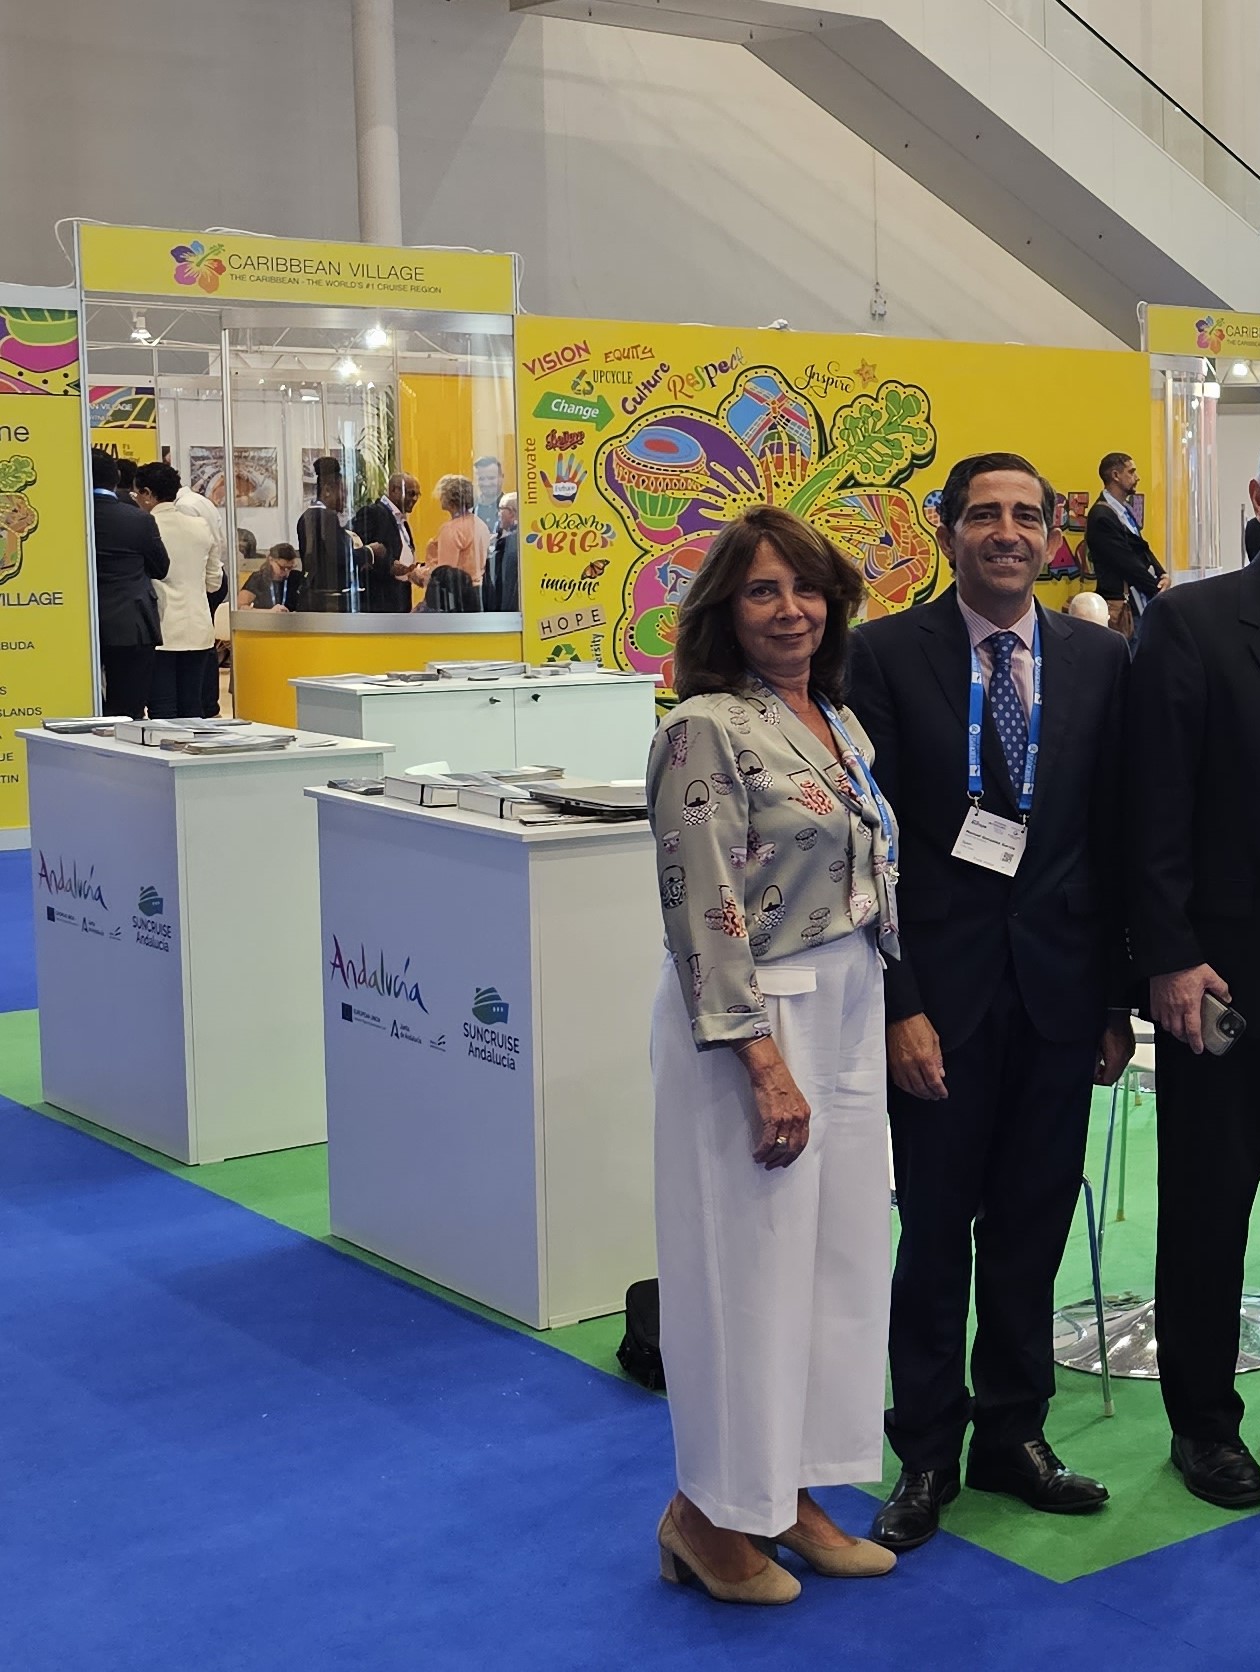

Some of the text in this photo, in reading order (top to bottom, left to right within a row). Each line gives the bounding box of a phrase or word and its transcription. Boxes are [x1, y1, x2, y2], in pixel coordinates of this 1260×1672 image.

[228, 254, 424, 281] CARIBBEAN VILLAGE
[250, 275, 299, 284] CARIBBEAN
[307, 278, 323, 286] THE
[378, 284, 408, 292] CRUISE
[410, 285, 441, 294] REGION
[522, 340, 591, 376] VISION
[593, 370, 632, 384] UPCYCLE
[622, 362, 671, 414] Culture
[551, 398, 600, 419] Change
[524, 438, 538, 504] innovate
[540, 573, 600, 601] imagine
[540, 609, 600, 635] HOPE
[38, 849, 109, 912] Andalucía
[132, 916, 172, 939] SUNCRUISE
[330, 934, 430, 1015] Andalucía
[464, 1022, 520, 1054] SUNCRUISE
[468, 1042, 516, 1071] Andalucía
